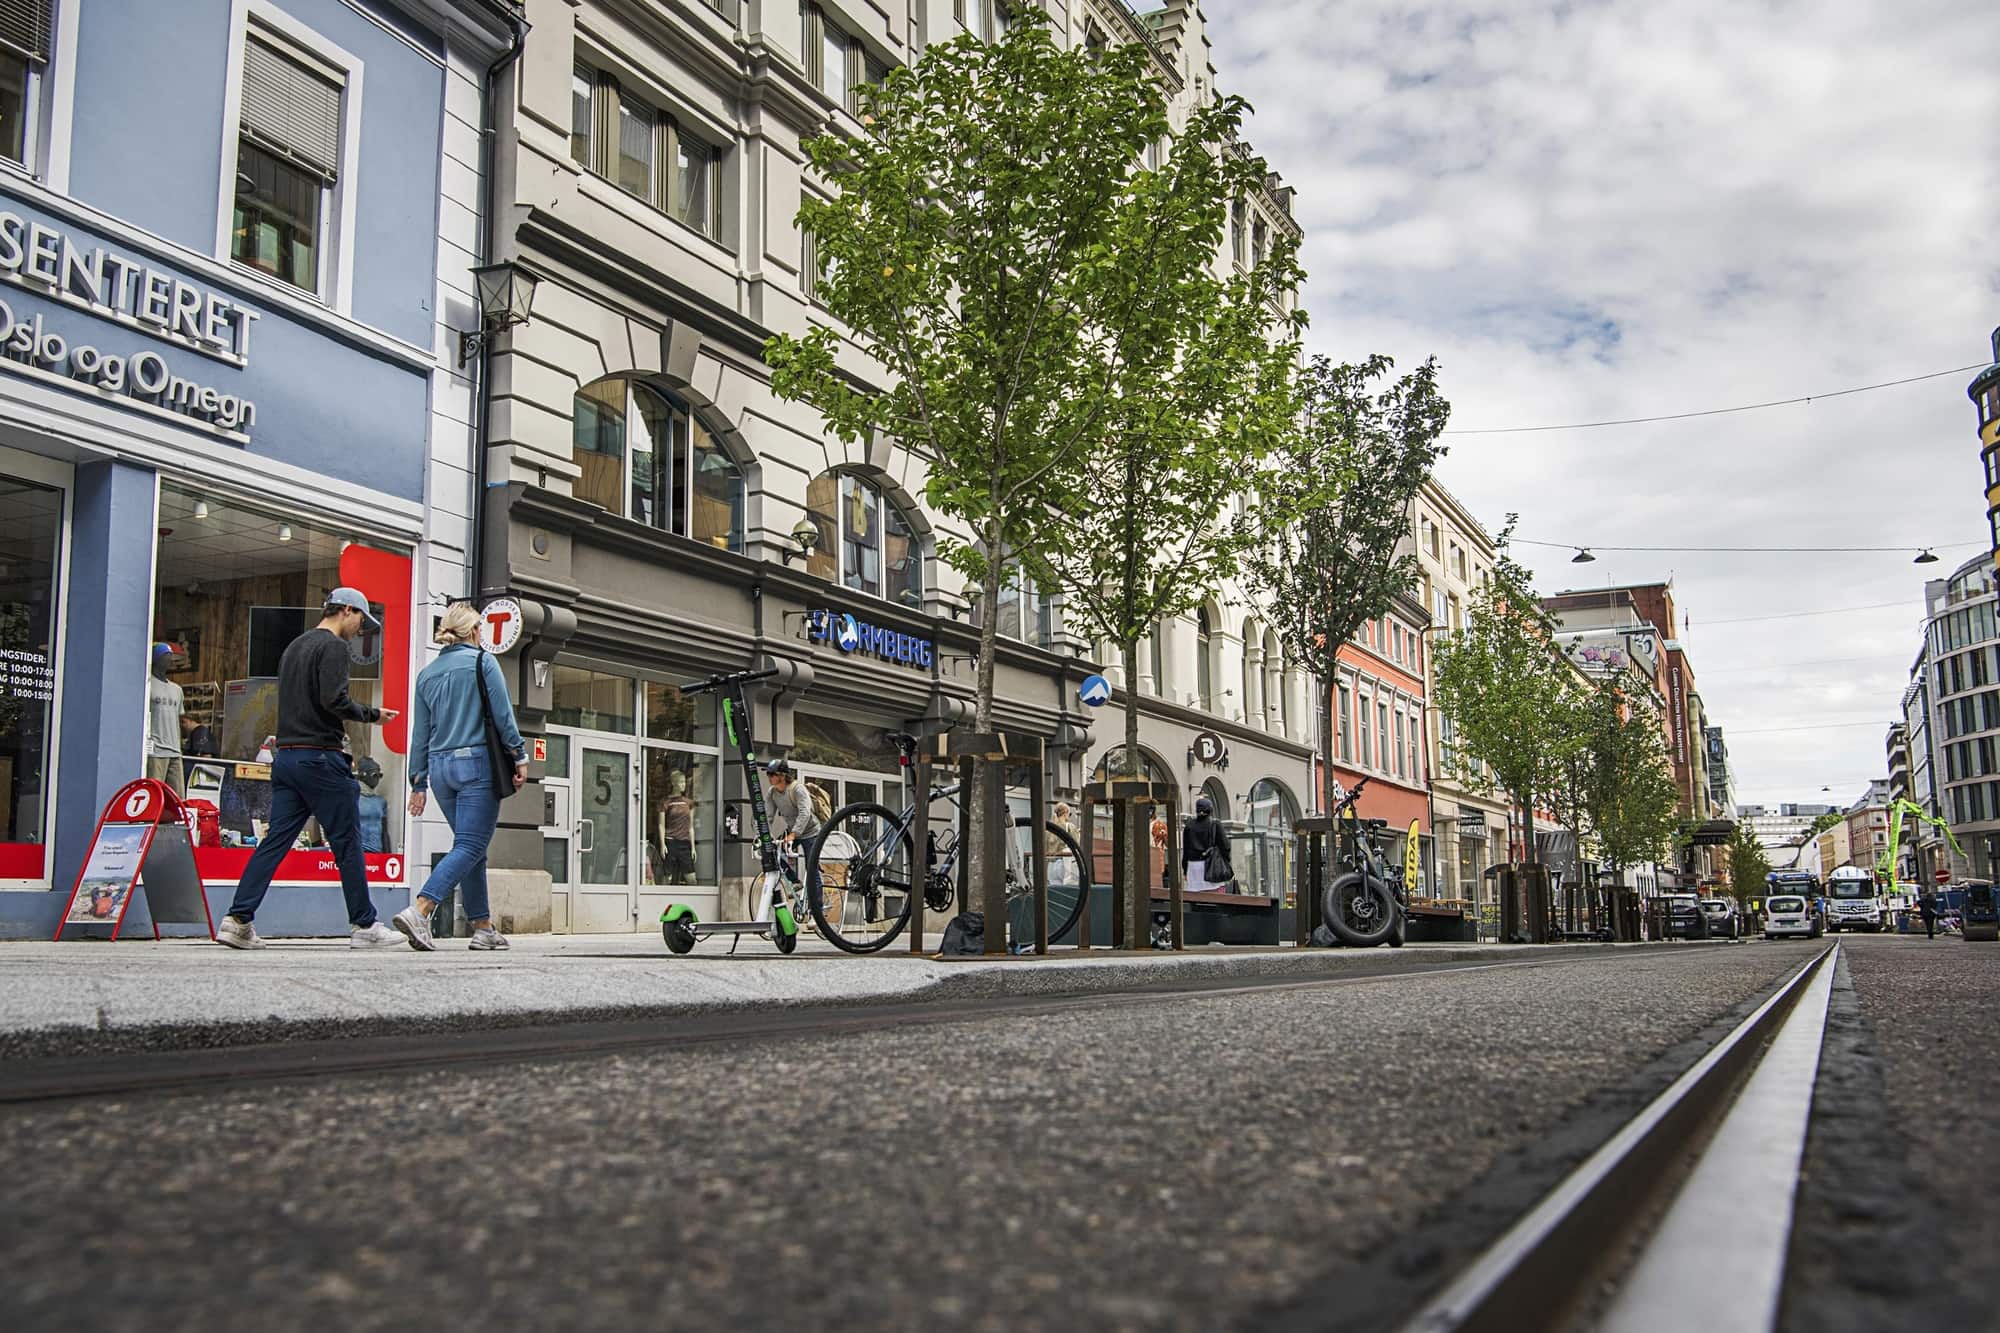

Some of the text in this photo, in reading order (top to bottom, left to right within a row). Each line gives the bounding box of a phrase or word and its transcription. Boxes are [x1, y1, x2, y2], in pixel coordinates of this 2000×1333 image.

[0, 211, 260, 357] SENTERET
[70, 345, 126, 391] og
[128, 351, 256, 428] Omegn
[486, 612, 512, 646] T
[813, 609, 932, 668] STORMBERG
[132, 795, 146, 812] T
[594, 764, 612, 806] 5
[389, 863, 397, 875] T
